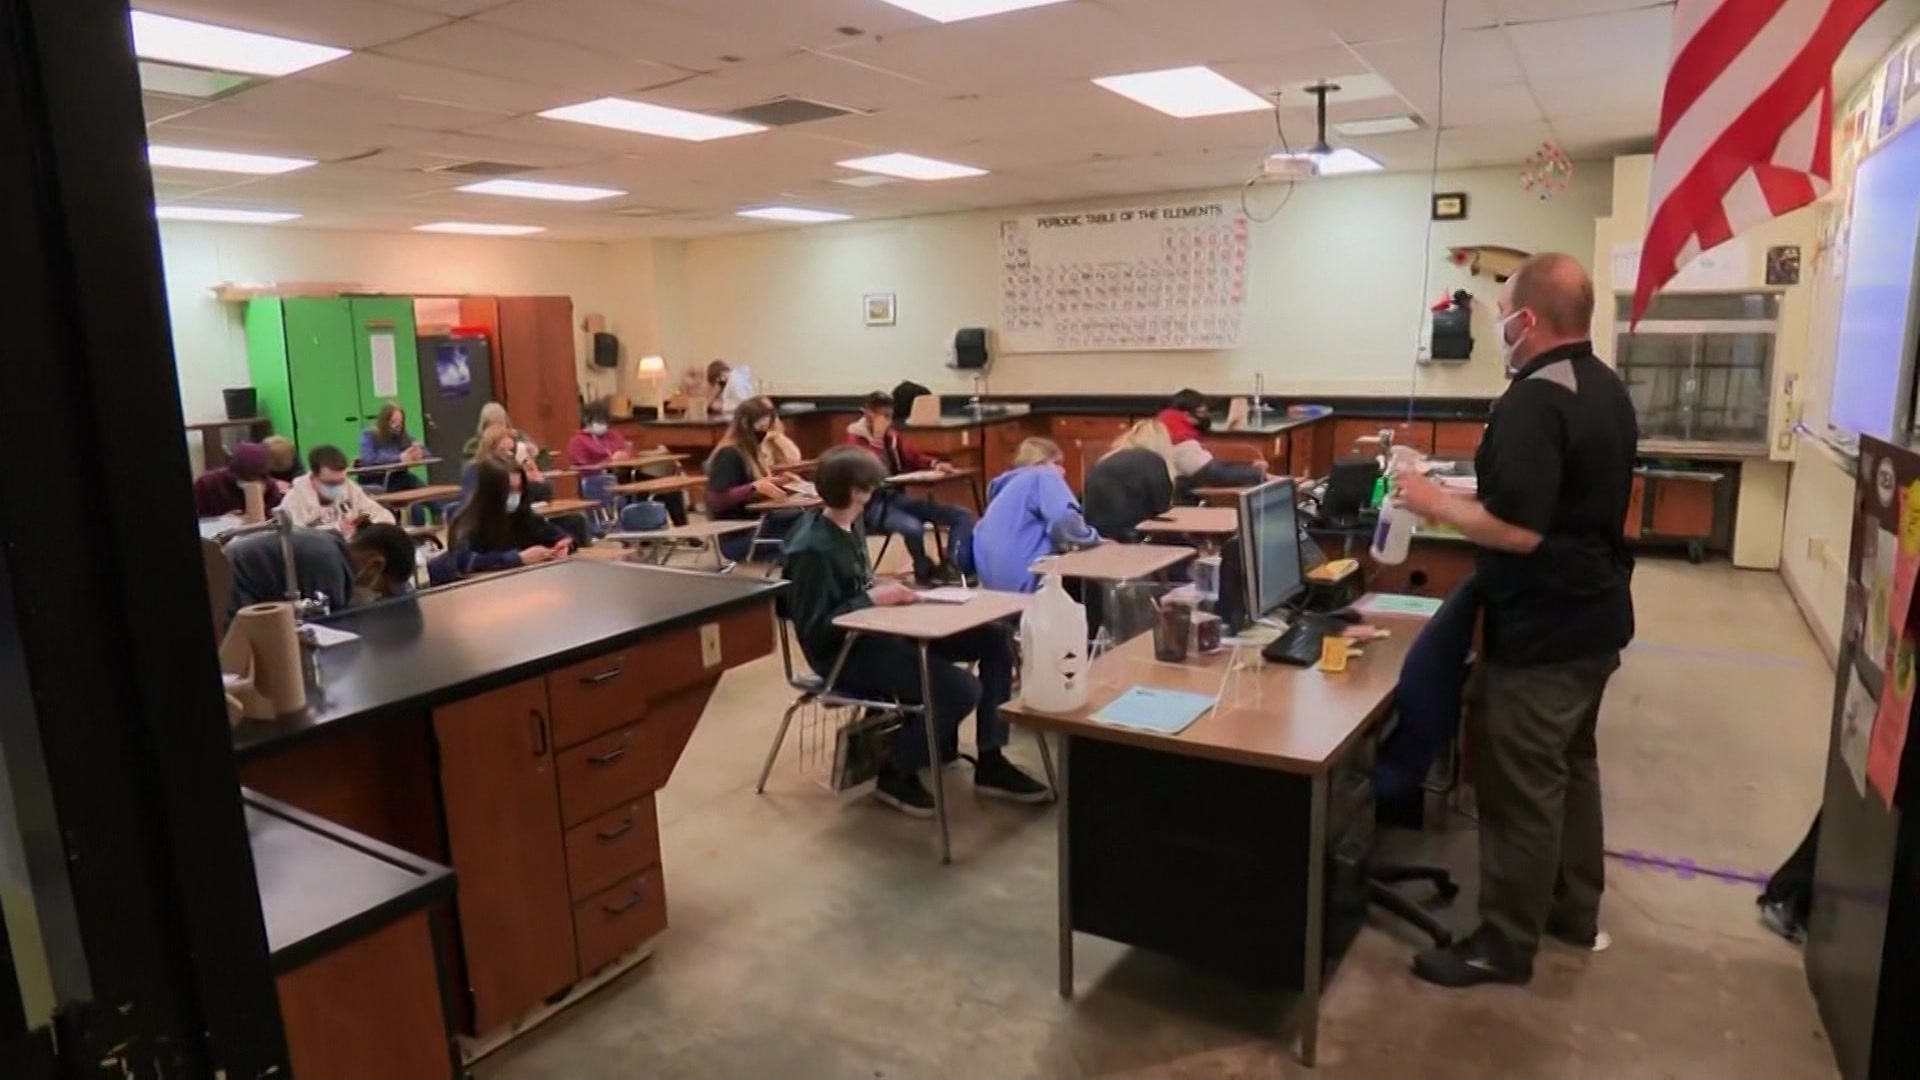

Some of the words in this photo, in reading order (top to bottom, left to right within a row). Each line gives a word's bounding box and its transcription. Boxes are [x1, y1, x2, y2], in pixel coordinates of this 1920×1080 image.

[1037, 215, 1082, 228] PERIODIC
[1085, 212, 1116, 223] TABLE
[1120, 210, 1134, 220] OF
[1138, 208, 1157, 219] THE
[1163, 203, 1222, 218] ELEMENTS
